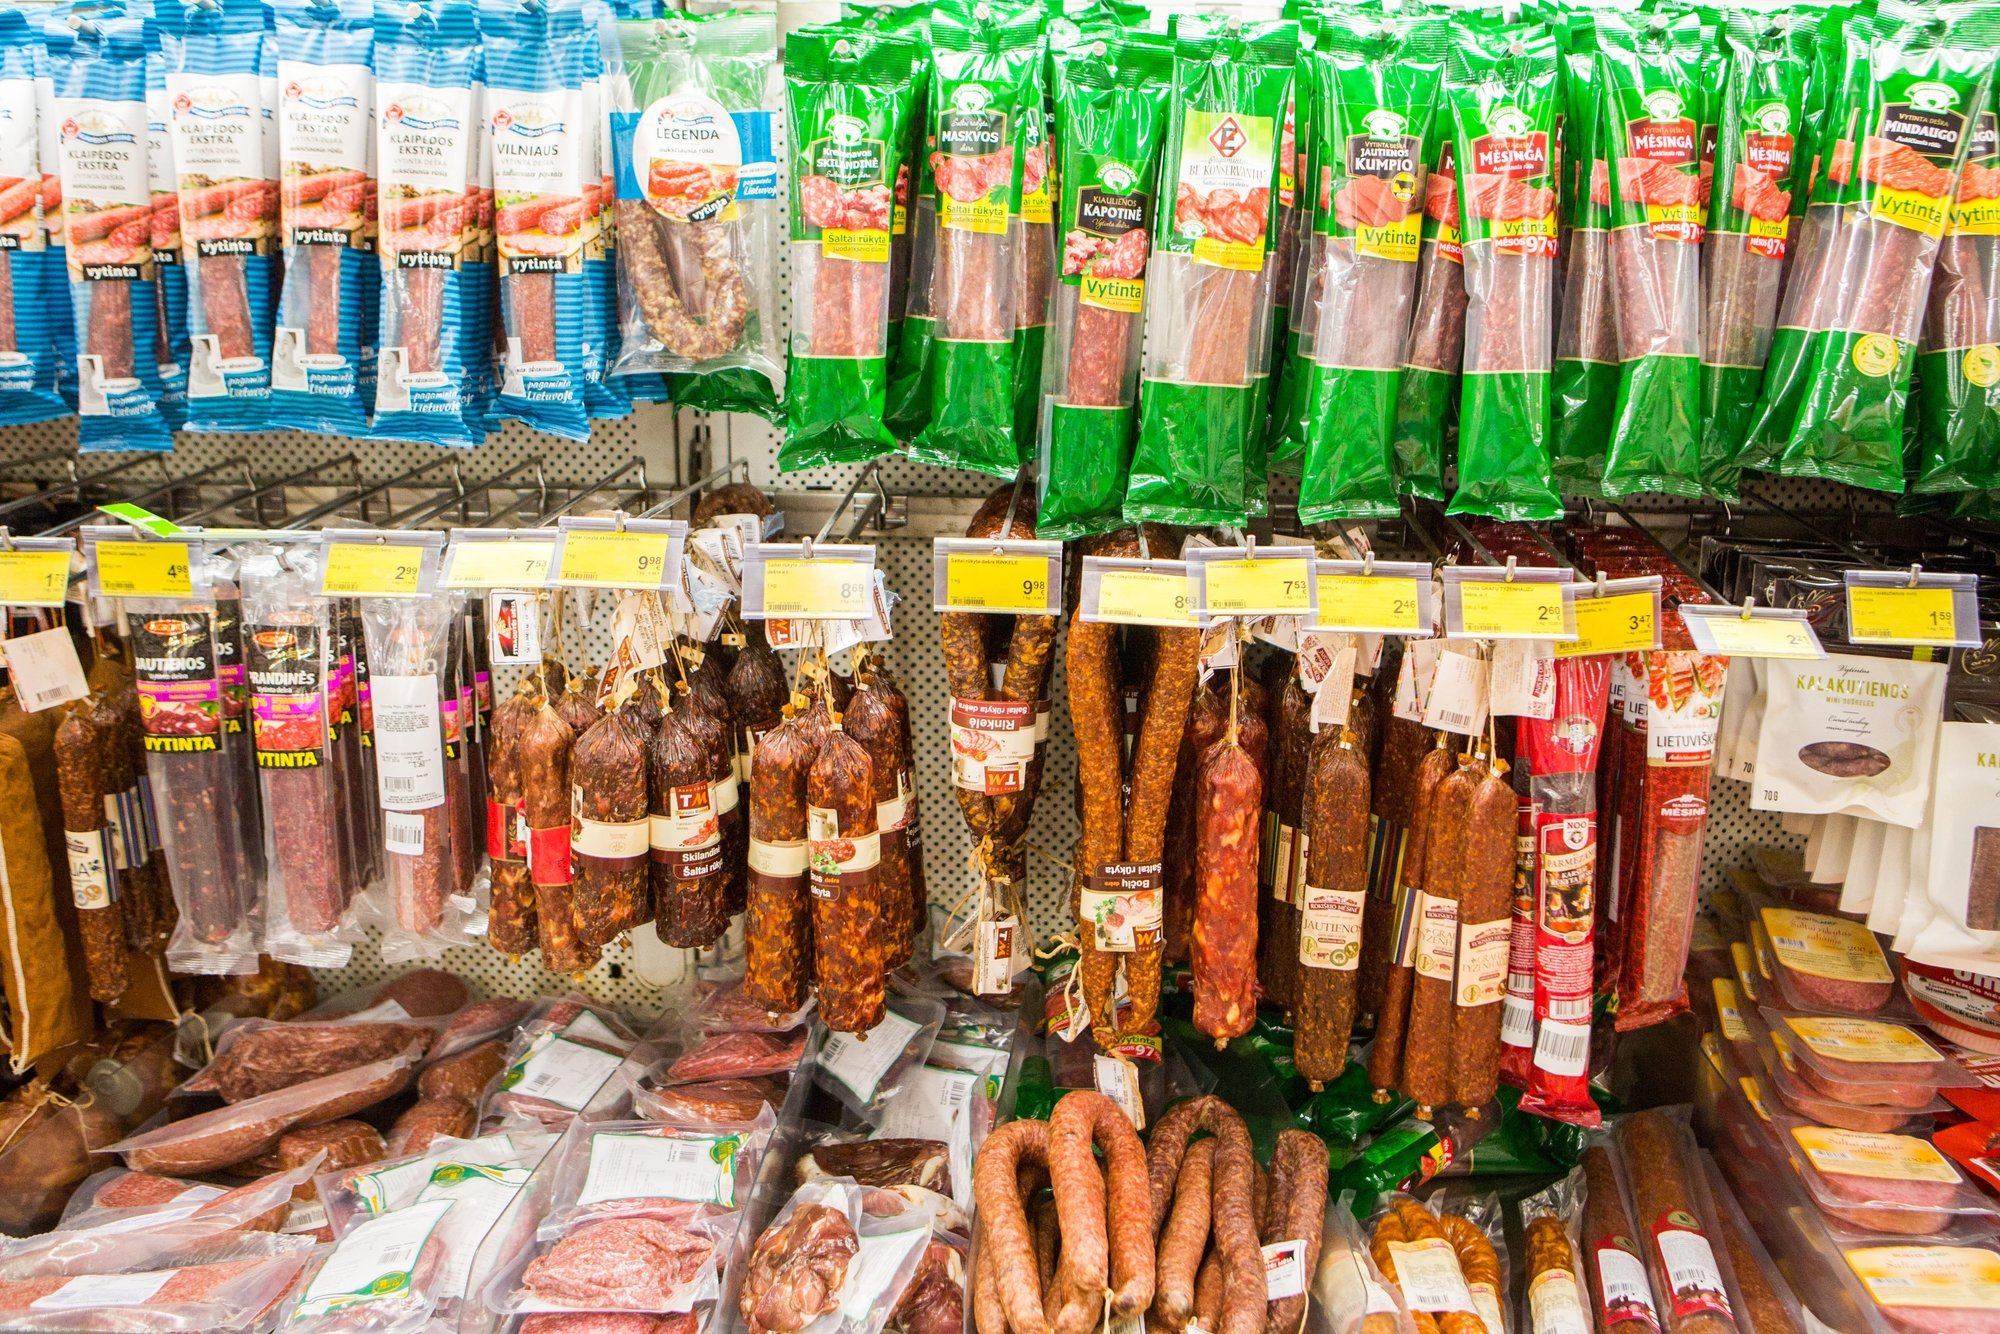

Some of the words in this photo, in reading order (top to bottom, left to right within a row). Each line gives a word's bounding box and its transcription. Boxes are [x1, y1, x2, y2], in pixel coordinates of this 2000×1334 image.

[297, 124, 339, 135] EKSTRA
[656, 128, 720, 140] LEGENDA
[1885, 119, 1957, 143] MINDAUGO
[190, 135, 234, 145] EKSTRA
[942, 130, 999, 143] MASKVOS
[1635, 133, 1693, 150] MĖSINGA
[399, 146, 442, 157] EKSTRA
[497, 143, 559, 157] VILNIAUS
[1360, 148, 1409, 158] JAUTIENOS
[1749, 147, 1790, 165] MĖSINGA
[1479, 148, 1544, 166] MĖSINGA
[77, 161, 119, 171] EKSTRA
[1189, 165, 1199, 176] BE
[1355, 158, 1413, 171] KUMPIO
[743, 187, 776, 196] Lietuvoj
[692, 195, 728, 220] vytinta
[1093, 195, 1137, 207] KIAULIENOS
[946, 204, 970, 214] Šaltai
[973, 206, 1004, 216] rūkyta
[1083, 203, 1142, 221] KAPOTINĖ
[1661, 208, 1697, 220] Vytinta
[1880, 194, 1942, 223] Vytinta
[1504, 223, 1548, 235] Vytinta
[1653, 223, 1681, 232] MĖSOS
[1759, 222, 1782, 235] Vytinta
[296, 228, 348, 244] vytinta
[828, 233, 855, 243] Šaltai
[858, 234, 886, 244] rūkyta
[1365, 228, 1416, 246] Vytinta
[1495, 236, 1525, 247] MĖSOS
[1750, 238, 1767, 247] MĖSOS
[200, 239, 253, 255] vytinta
[401, 251, 452, 268] vytinta
[512, 255, 562, 272] vytinta
[86, 265, 138, 279] vytinta
[1087, 280, 1141, 298] Vytinta
[527, 380, 571, 391] pagaminta
[526, 389, 573, 403] Lietuvoje
[412, 400, 461, 413] Lietuvoje
[1797, 674, 1910, 699] KALAKUTIENOS
[969, 717, 1015, 731] Rinkelė
[1661, 806, 1707, 817] MĖSINĖ
[683, 865, 709, 877] Šaltai
[1105, 864, 1136, 875] rūkyta
[1121, 879, 1150, 889] Bočių
[1942, 976, 1982, 994] UTENOS
